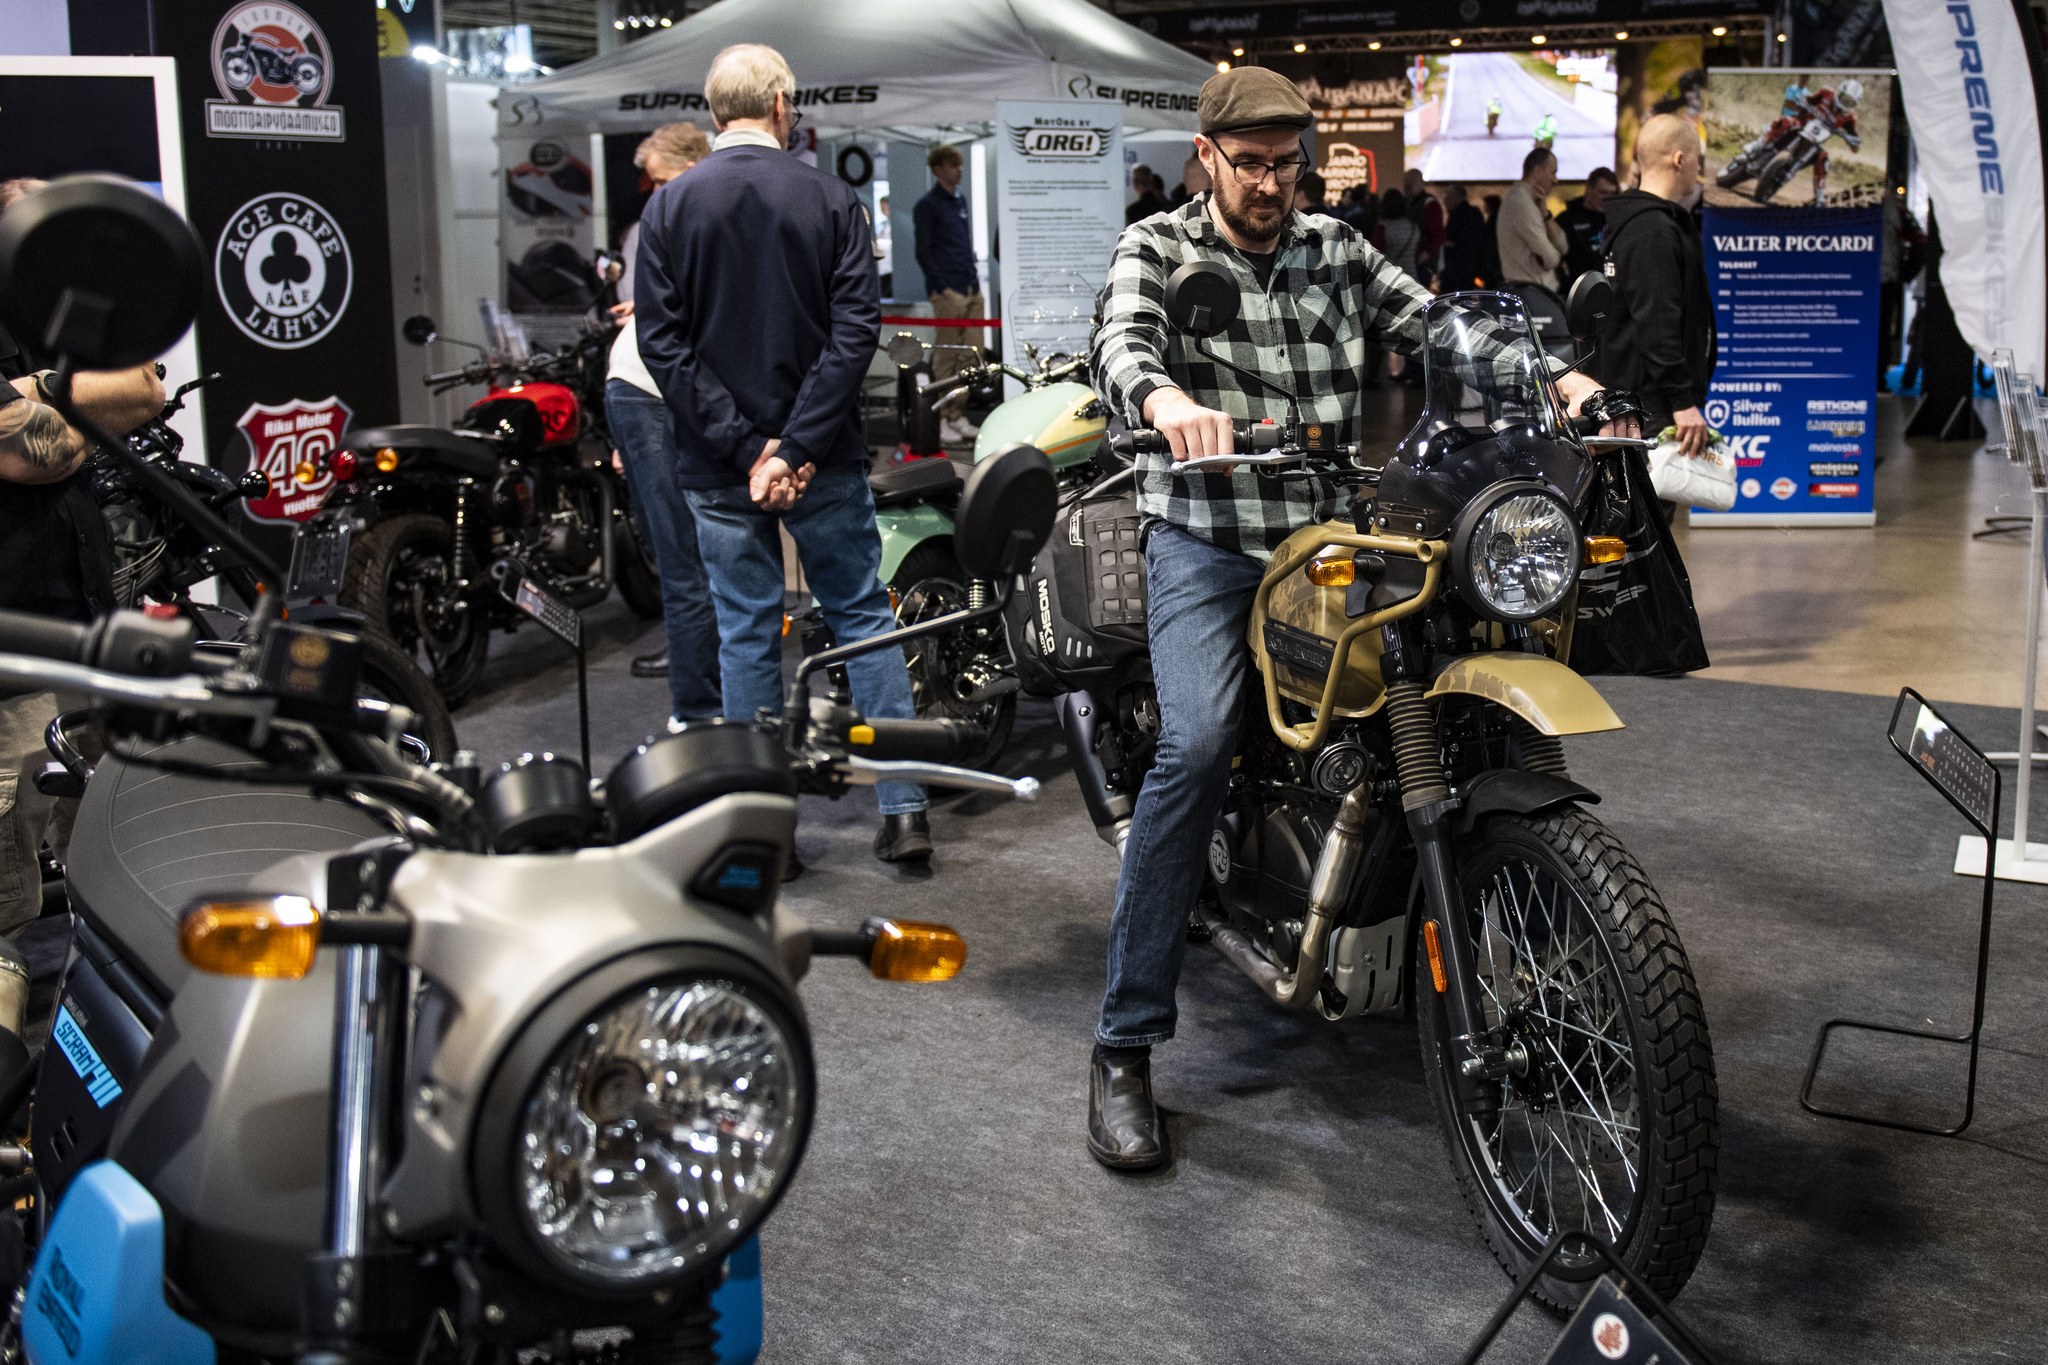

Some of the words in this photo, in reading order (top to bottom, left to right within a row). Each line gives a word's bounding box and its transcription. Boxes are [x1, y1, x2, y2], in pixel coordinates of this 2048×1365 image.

[618, 93, 710, 111] SUPR
[789, 85, 880, 106] BIKES
[1096, 86, 1199, 112] SUPREME
[1946, 0, 2004, 195] PREME
[1029, 134, 1093, 152] .ORG!
[227, 204, 274, 261] ACE
[281, 201, 342, 258] CAFE
[1713, 235, 1781, 251] VALTER
[1785, 235, 1873, 251] PICCARDI
[245, 302, 331, 339] LAHTI
[1710, 382, 1762, 393] POWERED
[1764, 382, 1782, 392] BY:
[1732, 398, 1772, 413] Silver
[265, 419, 294, 438] Riku
[296, 411, 335, 431] Motor
[1732, 413, 1781, 427] Bullion
[1037, 578, 1056, 654] MOSKO
[1038, 631, 1048, 656] MOTO
[56, 1020, 97, 1073] SCRAM
